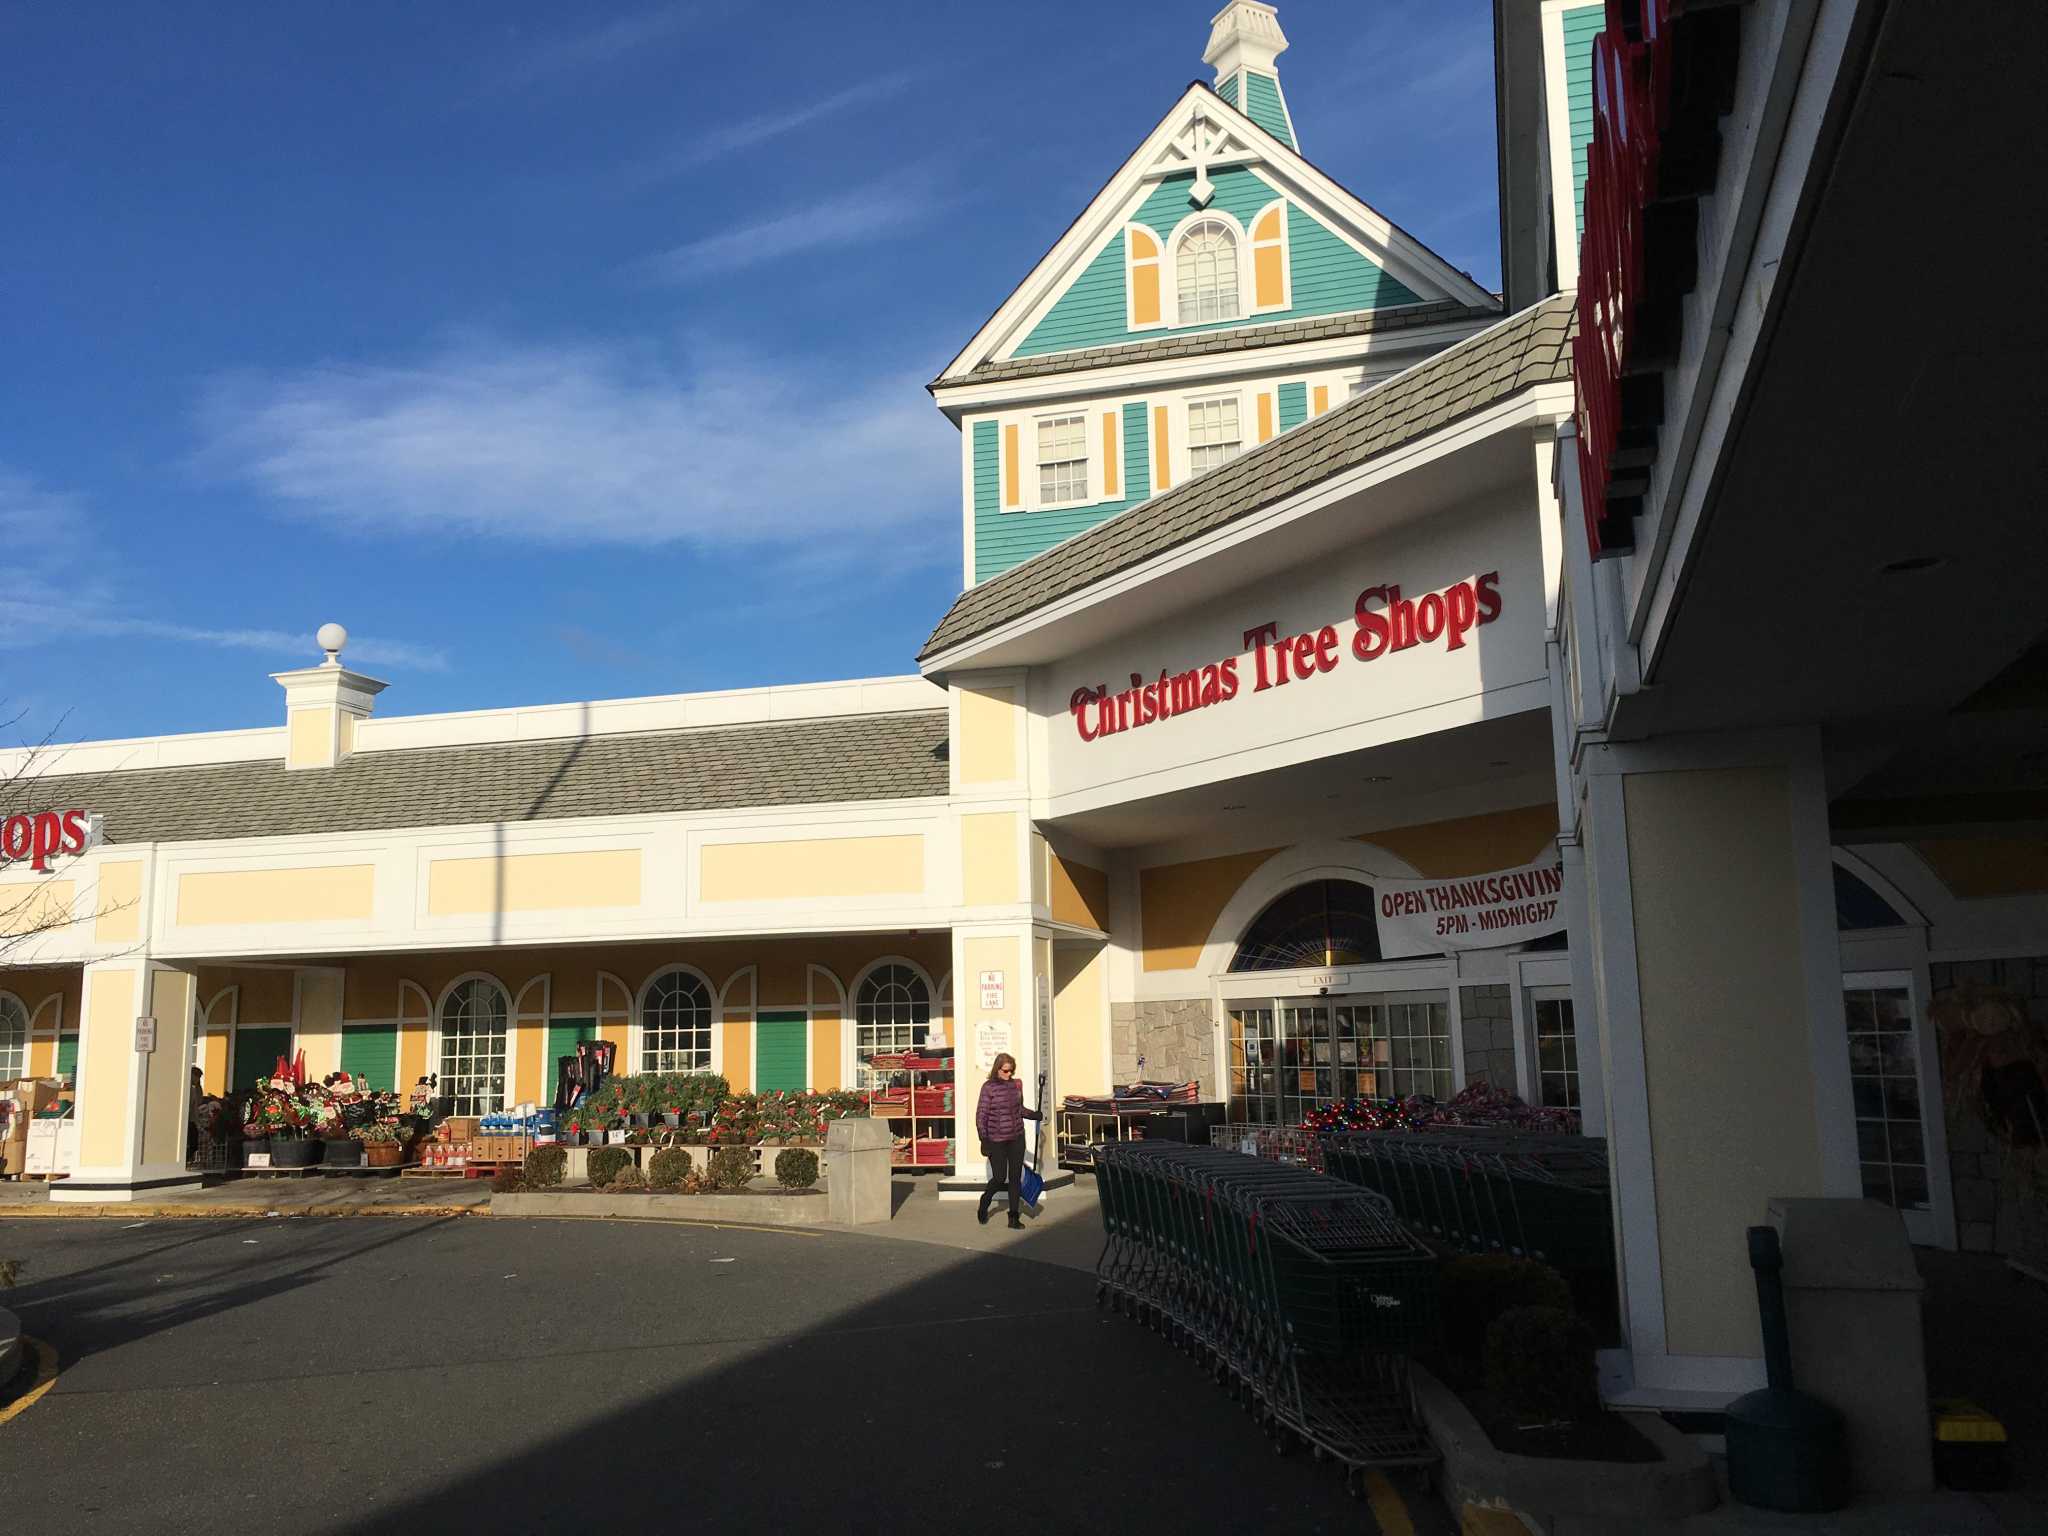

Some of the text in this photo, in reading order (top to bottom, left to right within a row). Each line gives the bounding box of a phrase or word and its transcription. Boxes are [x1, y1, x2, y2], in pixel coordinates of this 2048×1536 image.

[1070, 571, 1502, 743] Christmas Tree Shops
[0, 809, 85, 870] ops
[1381, 868, 1562, 918] OPEN THANKSGIVIN
[1436, 914, 1470, 936] 5PM
[1477, 899, 1559, 931] MIDNIGHT
